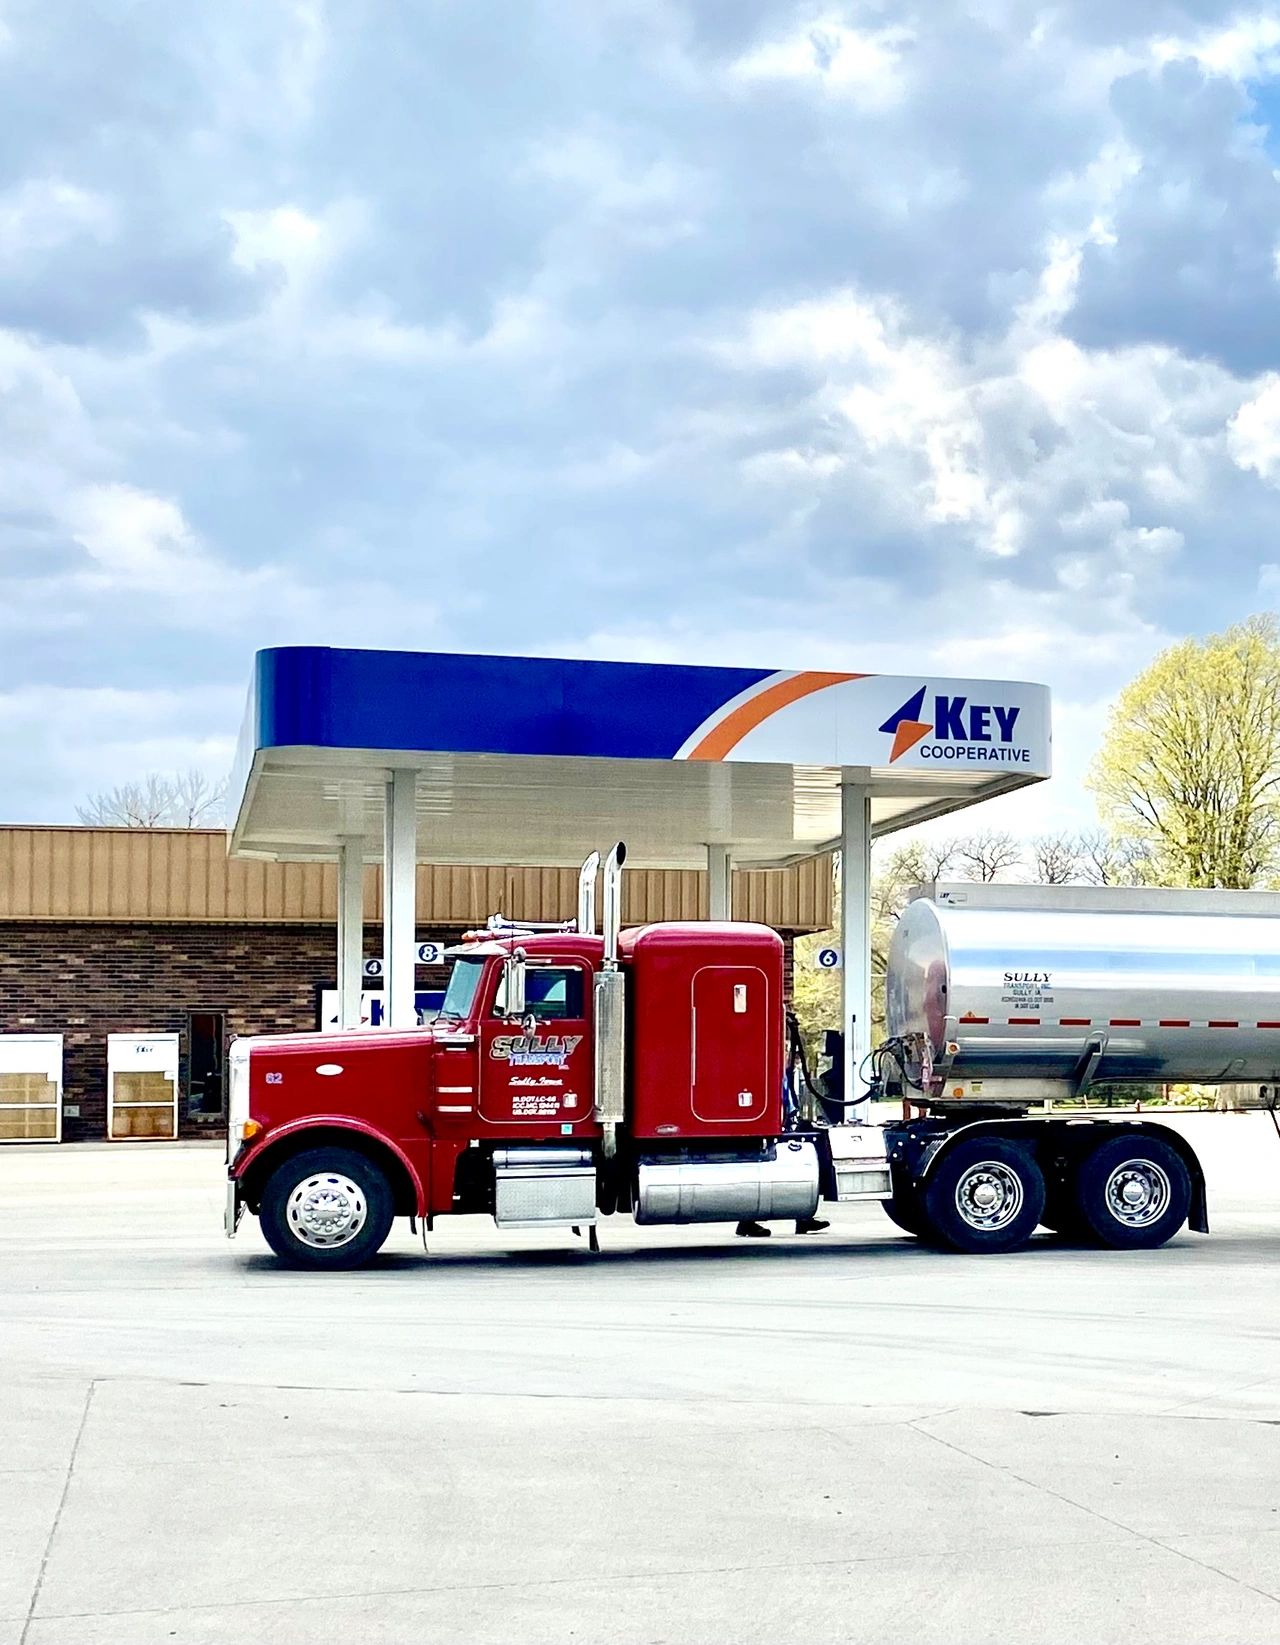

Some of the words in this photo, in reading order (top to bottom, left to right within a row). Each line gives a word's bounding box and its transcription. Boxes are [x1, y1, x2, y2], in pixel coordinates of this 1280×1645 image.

[935, 696, 1020, 742] KEY
[920, 745, 1030, 762] COOPERATIVE
[421, 945, 434, 961] 8
[822, 951, 834, 966] 6
[368, 961, 379, 973] 4
[1003, 972, 1053, 983] SULLY
[489, 1035, 583, 1060] SULLY
